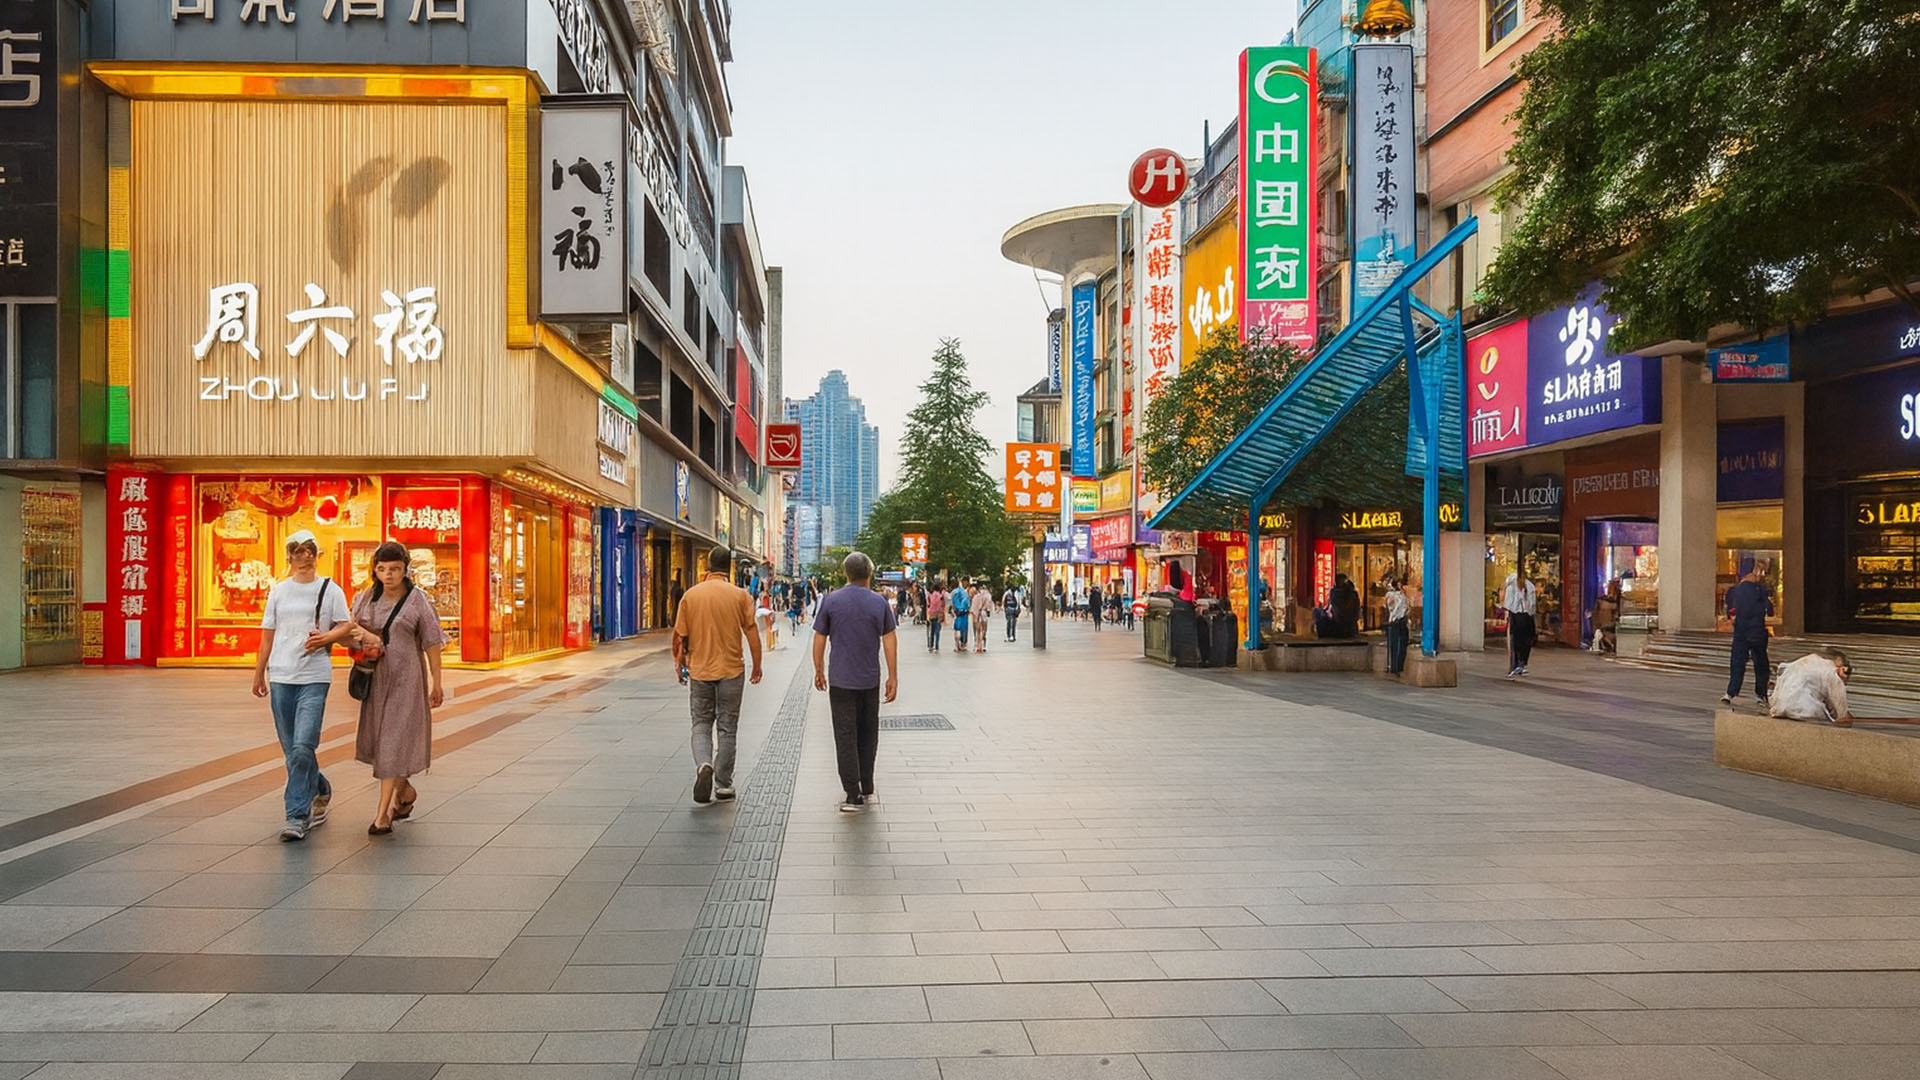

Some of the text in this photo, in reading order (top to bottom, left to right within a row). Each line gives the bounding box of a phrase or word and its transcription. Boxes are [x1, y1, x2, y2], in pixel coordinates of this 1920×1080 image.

[192, 282, 444, 366] 周六福
[199, 376, 299, 400] ZHOU
